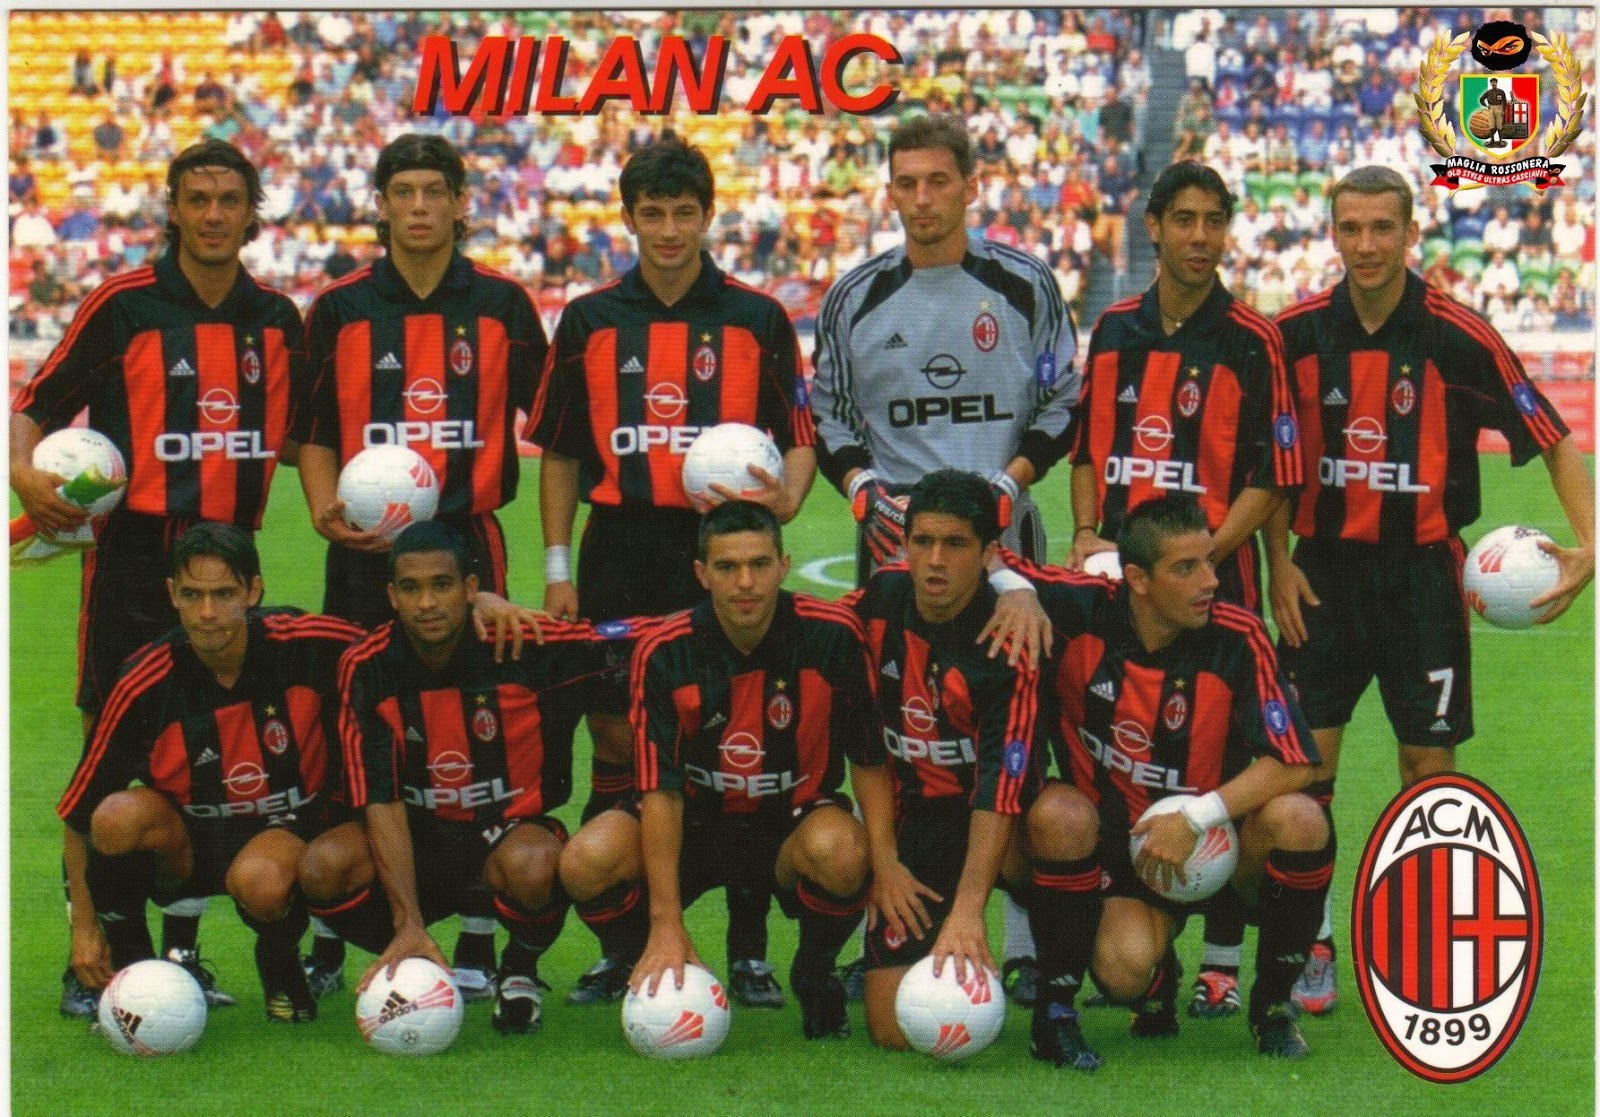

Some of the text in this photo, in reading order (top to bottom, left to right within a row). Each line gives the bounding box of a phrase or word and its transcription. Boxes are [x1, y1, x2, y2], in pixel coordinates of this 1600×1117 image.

[888, 394, 1014, 428] OPEL
[154, 430, 276, 462] OPEL
[362, 420, 485, 450] OPEL
[610, 425, 711, 456] OPE
[1104, 456, 1207, 494] OPEL
[1318, 456, 1431, 493] OPEL
[1427, 667, 1454, 716] 7
[1078, 726, 1199, 793] OPEL
[684, 763, 810, 799] OPEL
[183, 786, 318, 818] OPEL
